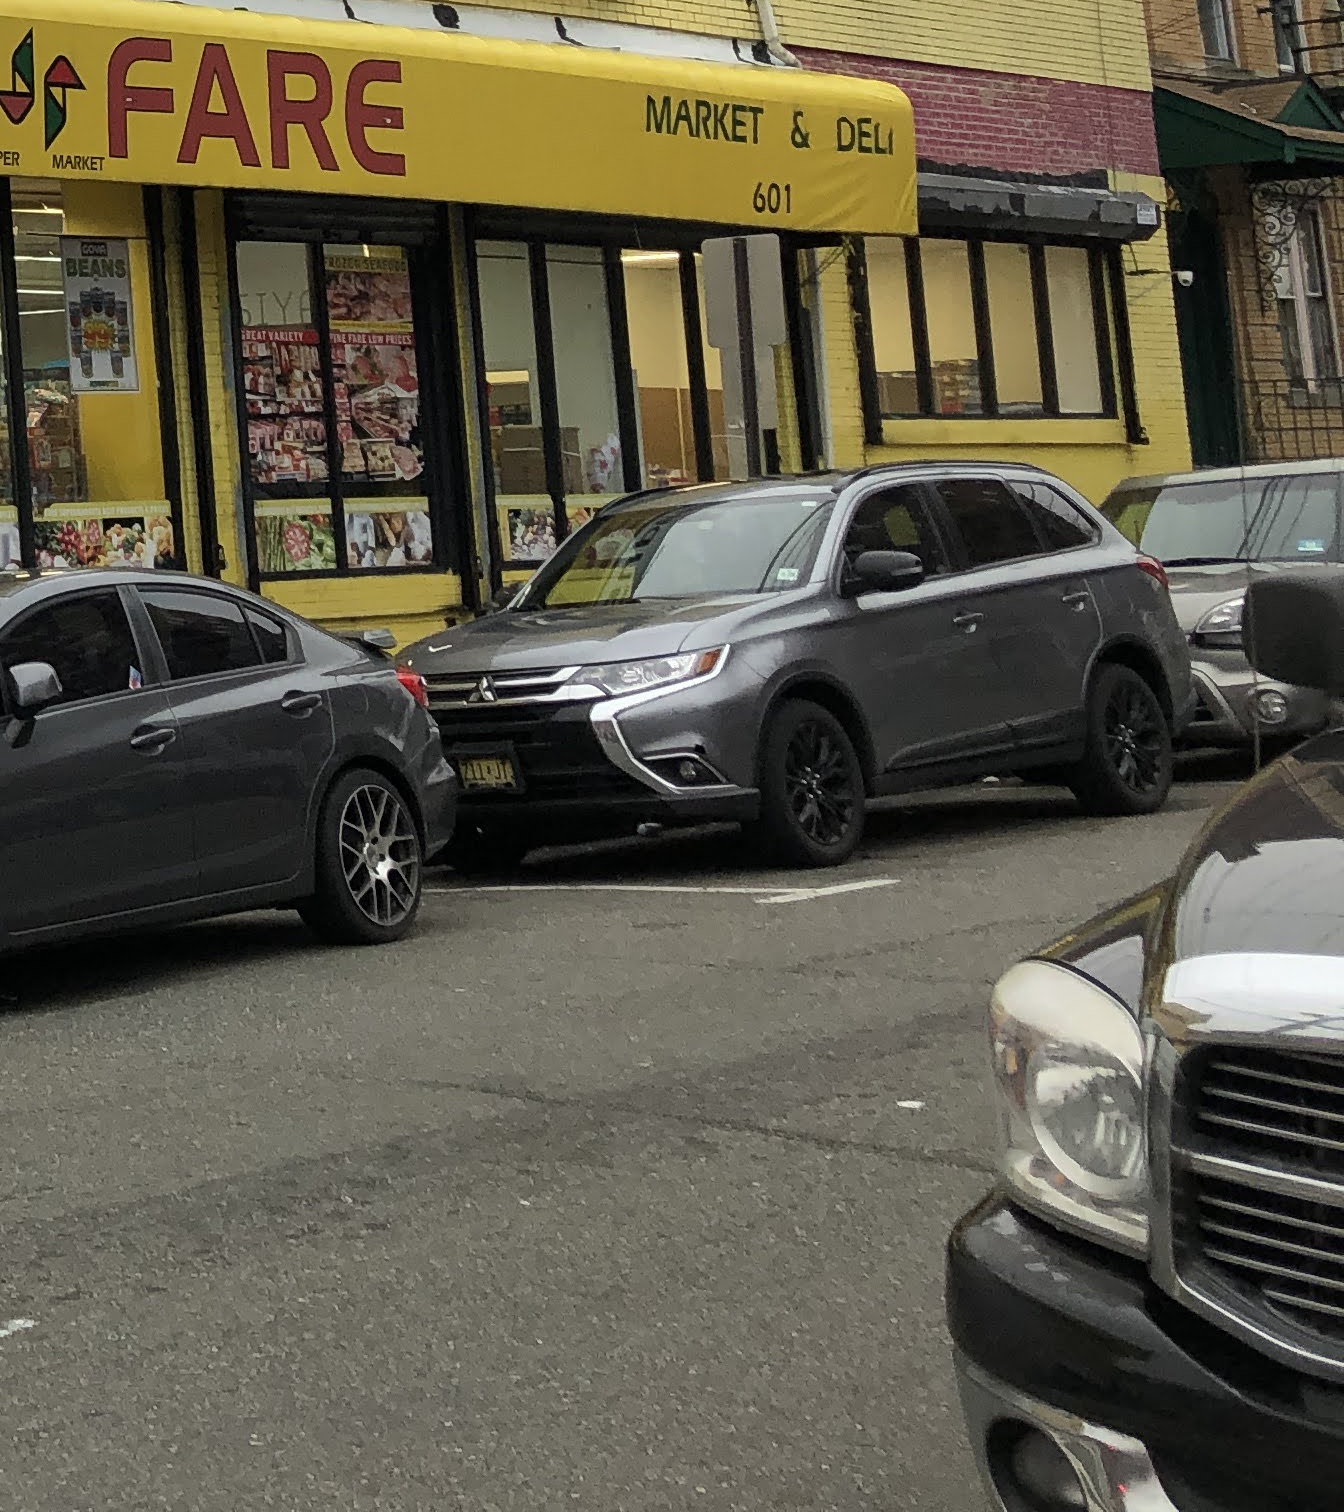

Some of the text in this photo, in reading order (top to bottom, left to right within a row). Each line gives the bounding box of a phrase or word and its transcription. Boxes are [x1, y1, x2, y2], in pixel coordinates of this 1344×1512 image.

[108, 36, 406, 177] FARE
[644, 94, 894, 157] MARKET & DELI
[52, 154, 106, 173] MARKET
[752, 180, 792, 215] 601
[82, 245, 107, 256] GOYA
[66, 258, 126, 278] BEANS
[268, 331, 303, 342] VARIETY
[348, 334, 366, 344] FARE
[368, 335, 383, 344] LOW
[386, 335, 412, 345] PRICES
